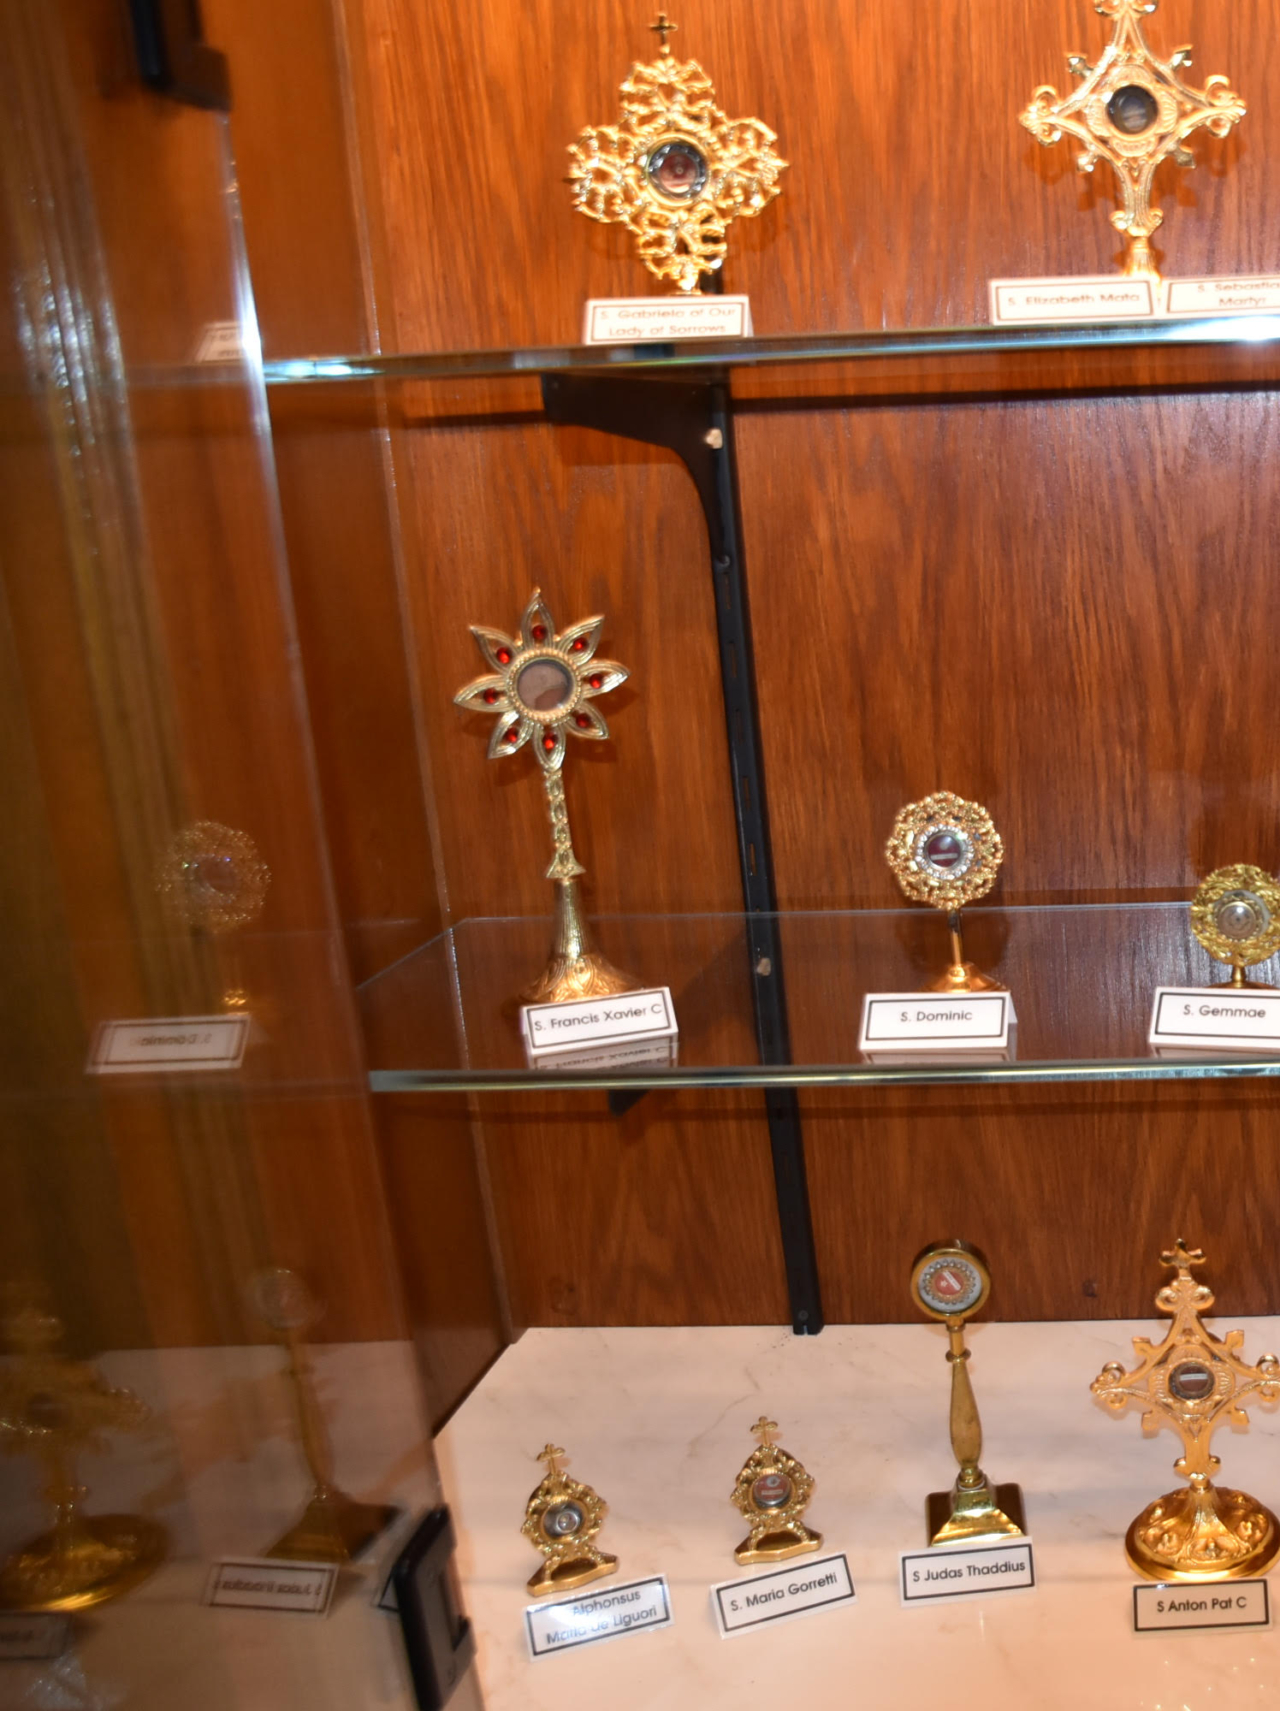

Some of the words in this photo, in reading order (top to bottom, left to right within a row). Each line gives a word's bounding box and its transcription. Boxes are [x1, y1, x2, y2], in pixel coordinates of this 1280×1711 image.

[1025, 294, 1096, 306] Elizabeth
[1218, 296, 1267, 308] Martyr
[690, 308, 704, 317] of
[708, 306, 736, 317] Our
[608, 325, 644, 338] Lady
[649, 325, 665, 335] of
[668, 324, 727, 335] Sorrows
[534, 1020, 546, 1032] S.
[550, 1014, 600, 1030] Francis
[603, 1006, 648, 1022] Xavier
[650, 1003, 663, 1015] C
[900, 1011, 912, 1022] S.
[916, 1009, 973, 1022] Dominic
[1183, 1004, 1194, 1016] S.
[1199, 1004, 1267, 1019] Gemmae
[912, 1570, 921, 1583] S
[924, 1567, 964, 1582] Judas
[966, 1561, 1026, 1577] Thaddius
[730, 1599, 743, 1612] S.
[745, 1588, 786, 1608] Maria
[788, 1571, 838, 1596] Gorretti
[573, 1589, 642, 1617] Alphonsus
[1157, 1600, 1165, 1613] S
[1168, 1598, 1208, 1613] Anton
[1211, 1597, 1233, 1611] Pat
[1236, 1596, 1248, 1609] C
[613, 1605, 658, 1627] Liguori
